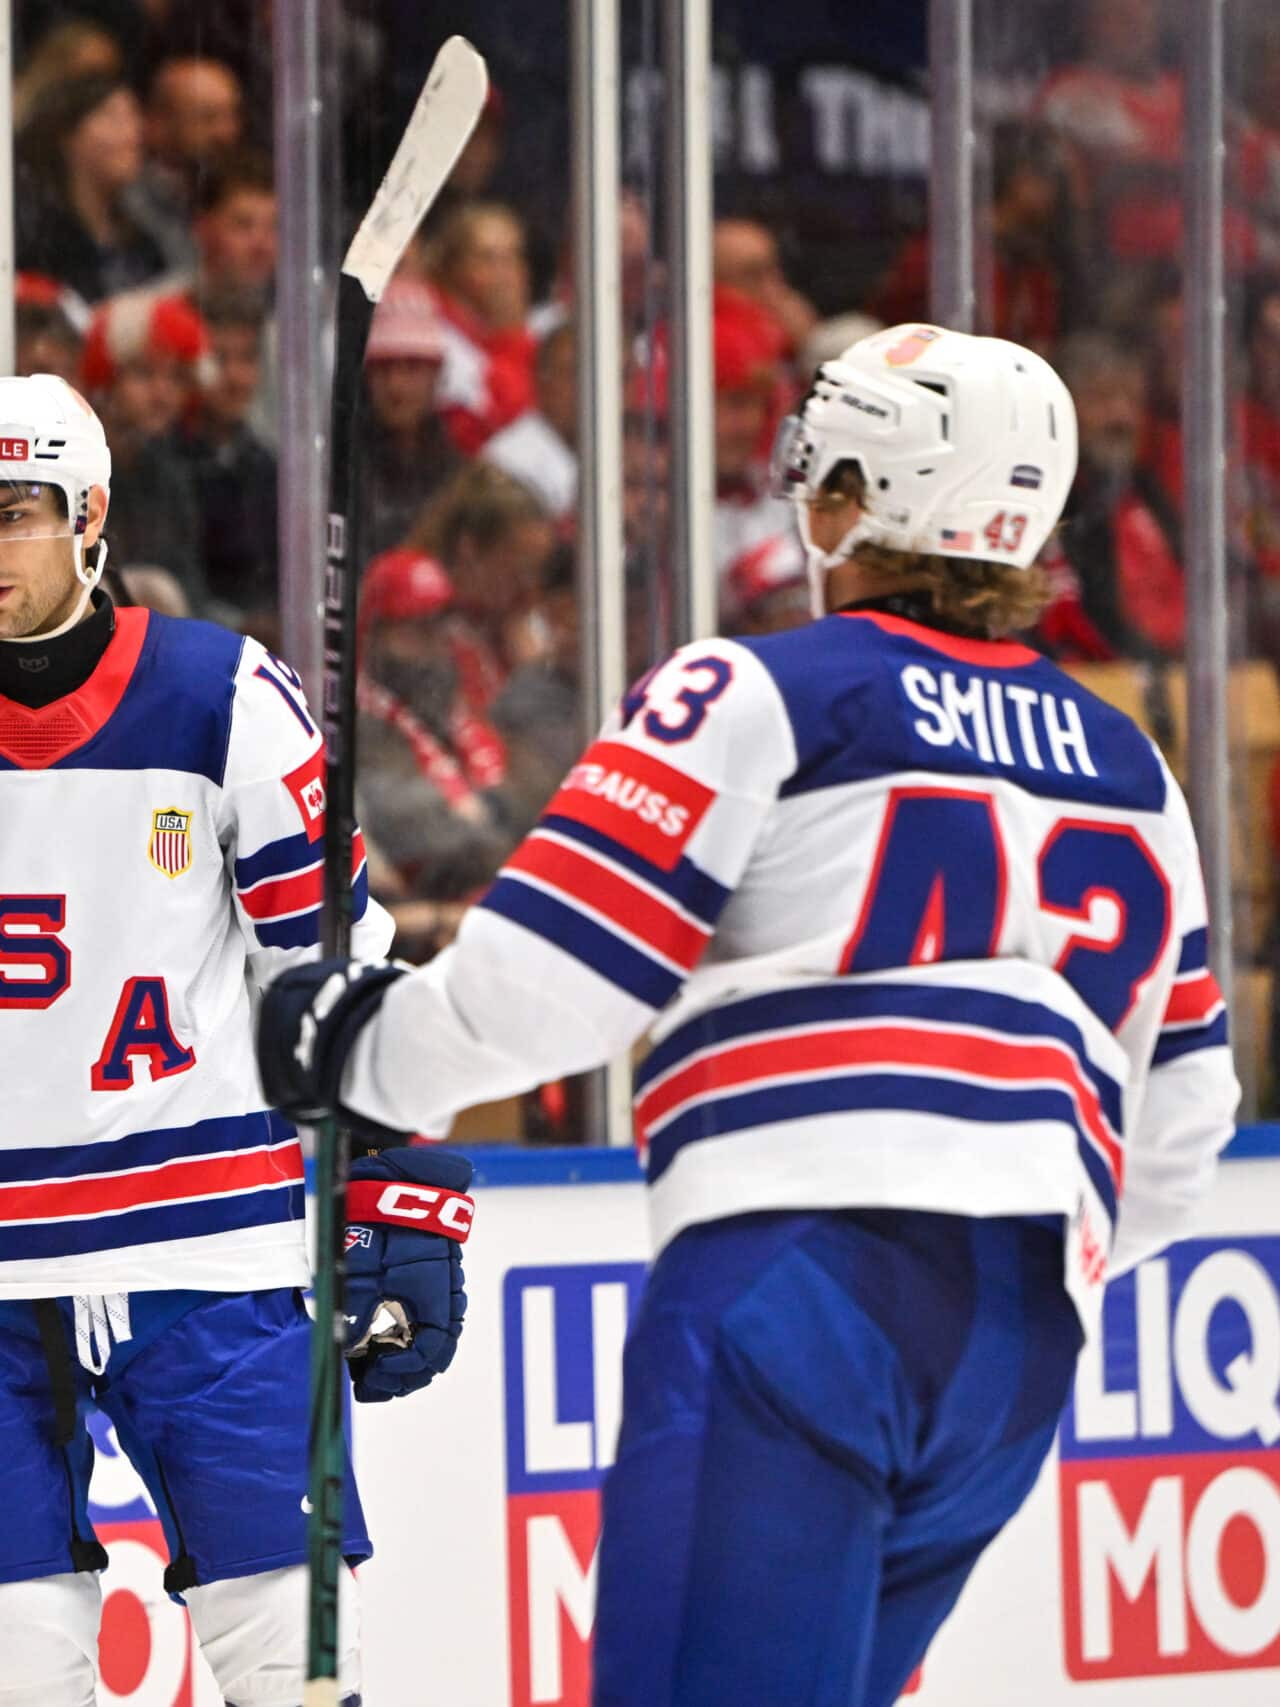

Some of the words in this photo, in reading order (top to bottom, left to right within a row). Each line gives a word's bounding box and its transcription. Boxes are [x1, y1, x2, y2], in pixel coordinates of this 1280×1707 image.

[984, 510, 1028, 553] 43
[900, 664, 1098, 778] SMITH
[160, 815, 183, 829] USA
[1076, 1466, 1280, 1662] MO
